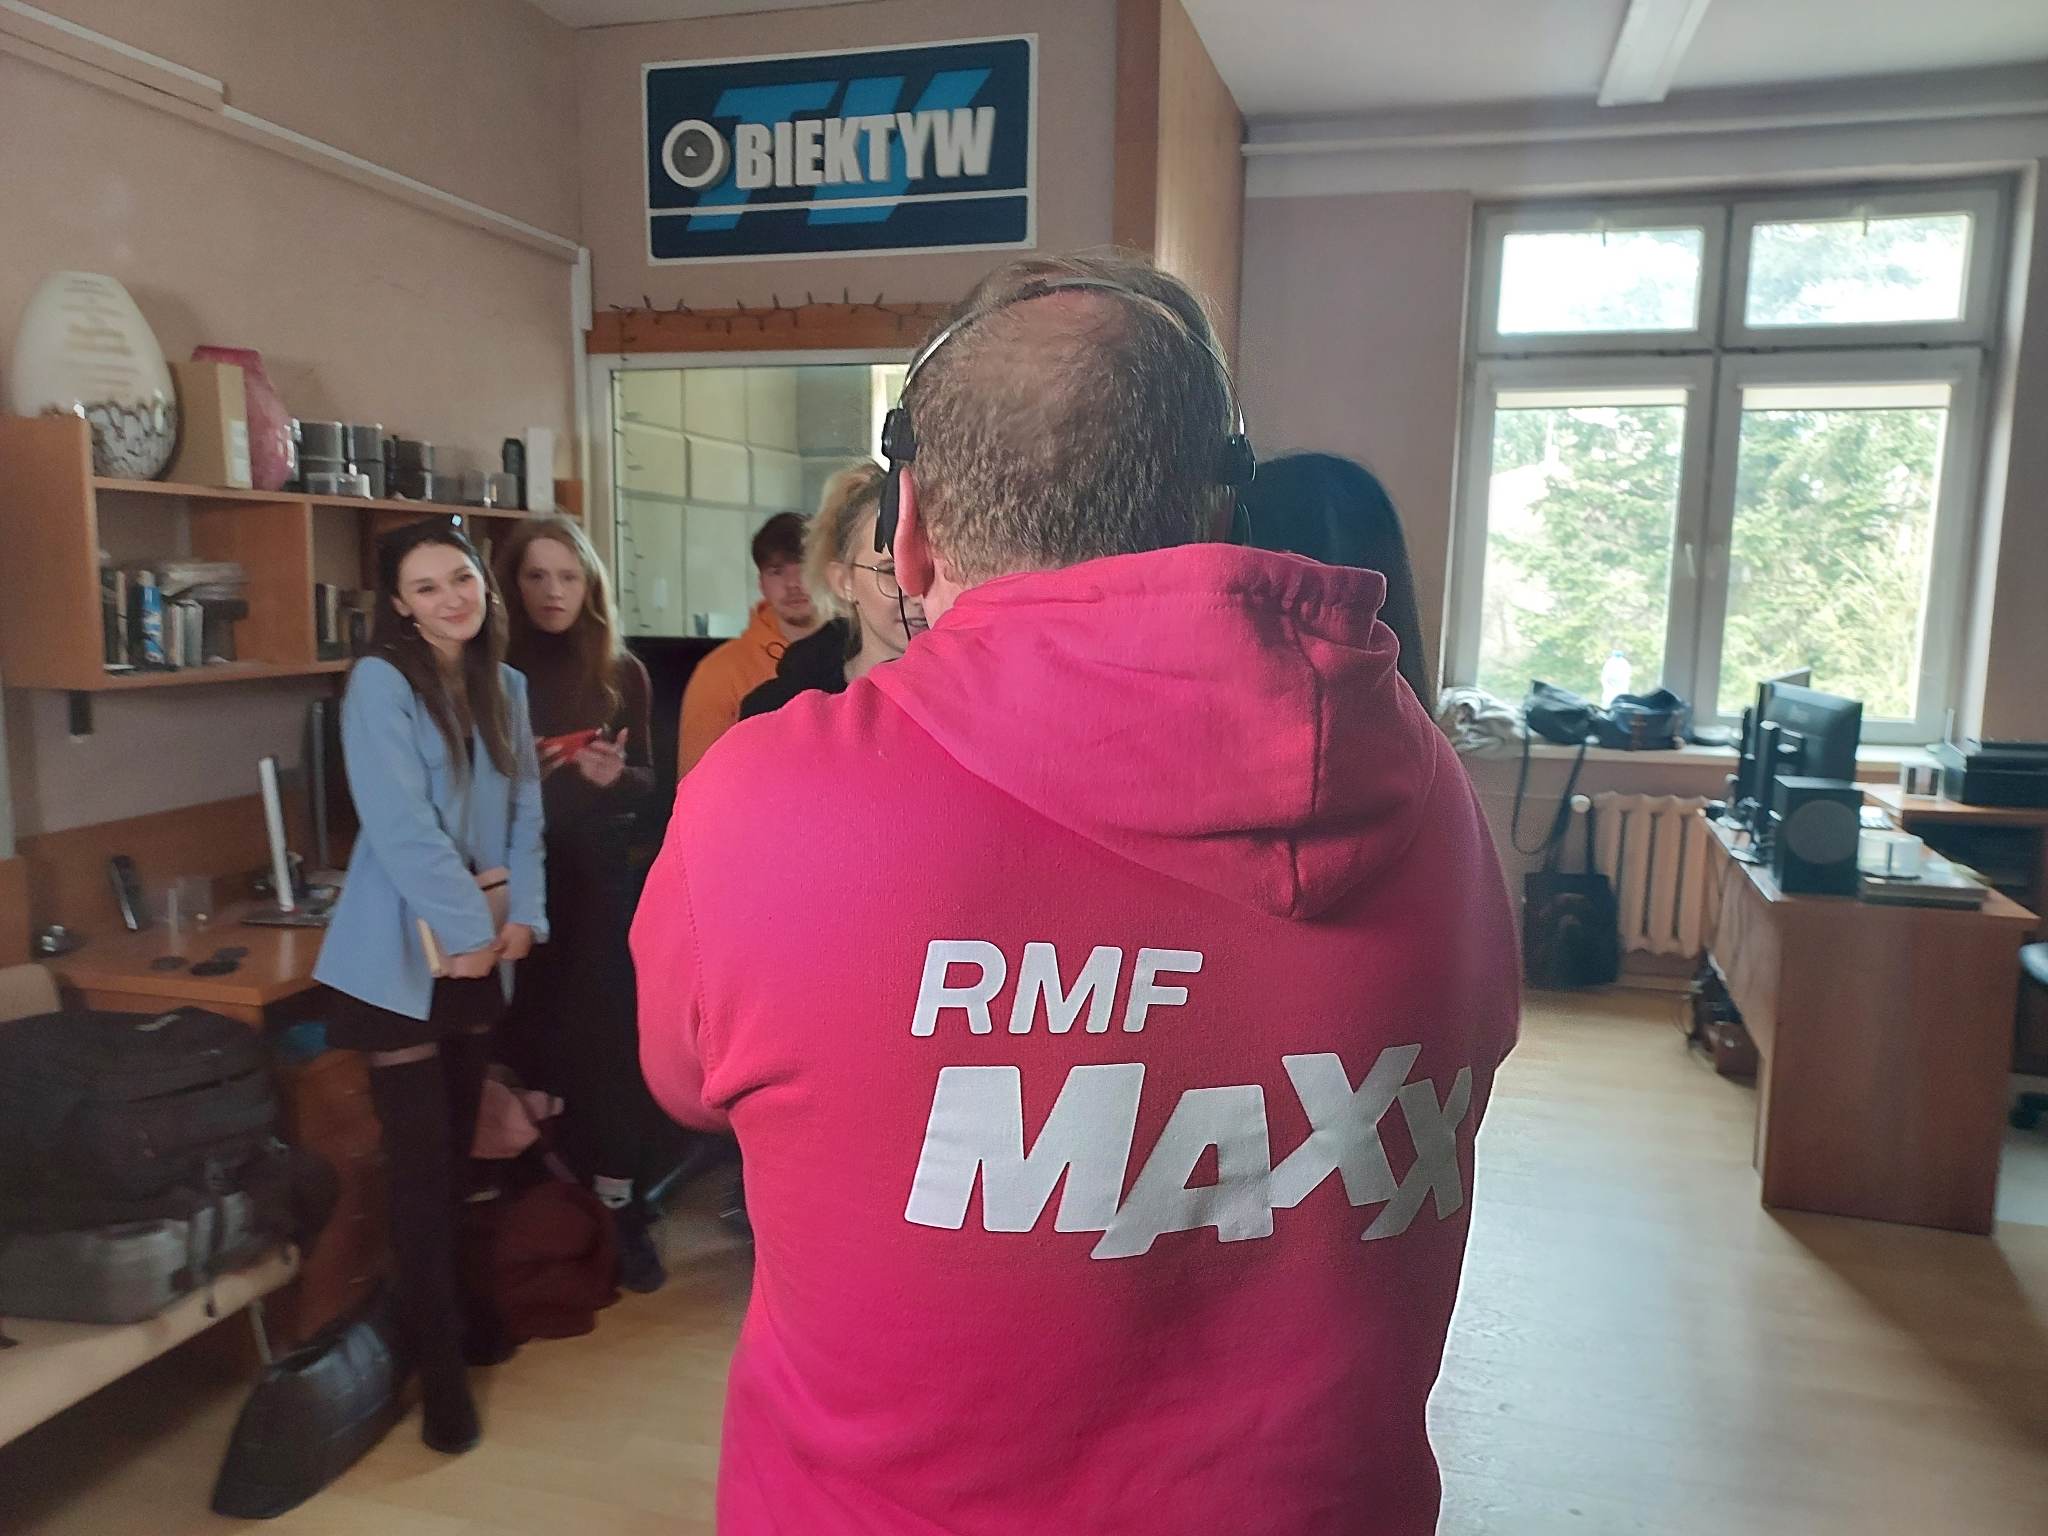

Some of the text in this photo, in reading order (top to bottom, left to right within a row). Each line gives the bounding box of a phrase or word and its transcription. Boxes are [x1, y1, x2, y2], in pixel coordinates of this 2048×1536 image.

[662, 106, 995, 189] OBIEKTYW
[910, 939, 1204, 1037] RMF
[904, 1043, 1473, 1260] MAXX
